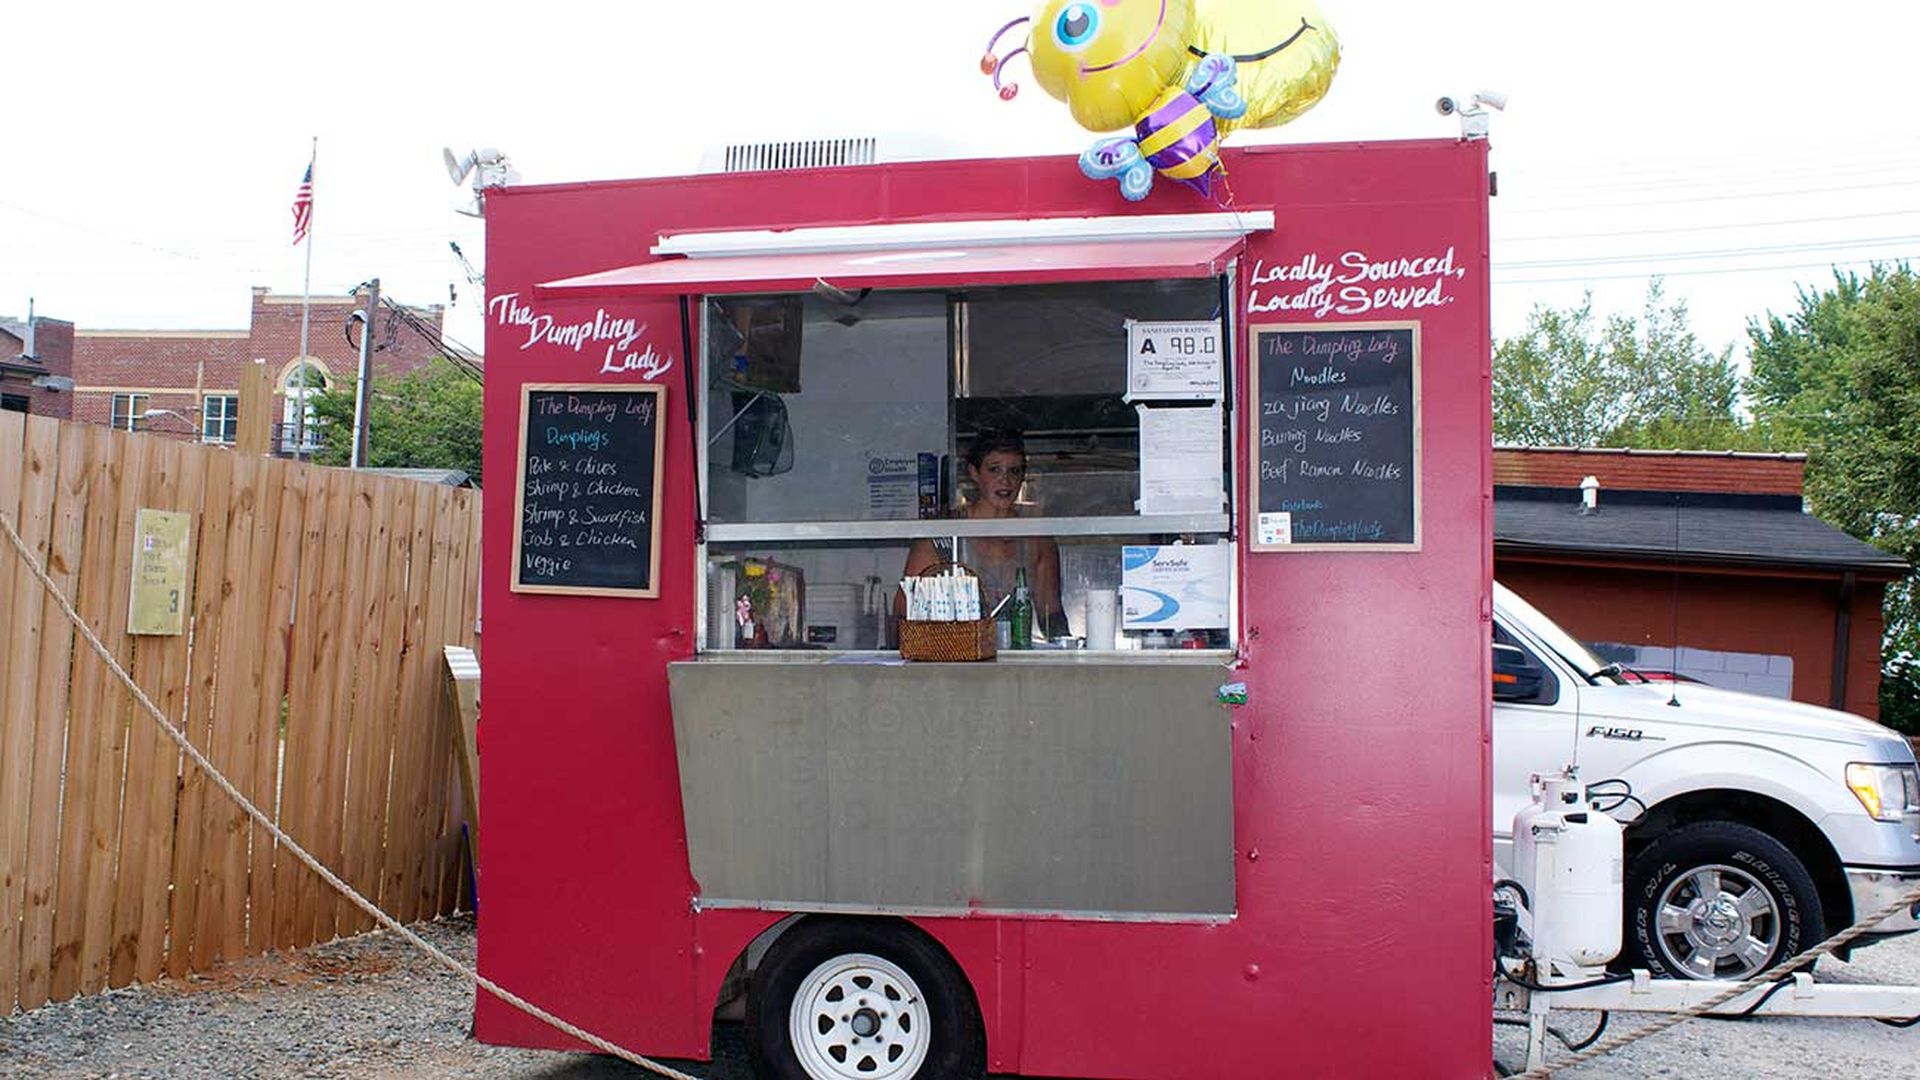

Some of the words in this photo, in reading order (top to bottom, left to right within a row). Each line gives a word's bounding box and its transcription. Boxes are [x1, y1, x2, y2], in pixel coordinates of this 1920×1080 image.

[1250, 253, 1336, 294] Locally
[1336, 246, 1465, 284] Sourced,
[489, 293, 534, 325] The
[1248, 285, 1336, 318] Locally
[1335, 278, 1454, 314] Served.
[520, 308, 646, 351] Dumpling
[1140, 338, 1156, 354] A
[1171, 336, 1215, 355] 98.0
[1264, 336, 1293, 355] The
[1303, 335, 1363, 363] Dumpling
[1368, 335, 1398, 363] Lady
[600, 343, 673, 380] Lady
[1290, 367, 1347, 388] Noodles
[537, 396, 564, 416] The
[568, 395, 617, 422] Dumpling
[625, 396, 654, 426] Lady
[1340, 394, 1400, 416] Noodles
[547, 427, 609, 450] Dumplings
[1315, 427, 1362, 444] Noodles
[1261, 459, 1290, 484] Beef
[1352, 460, 1401, 480] Noodles
[526, 480, 570, 501] Shrimp
[587, 480, 641, 498] Chicken
[524, 503, 565, 529] Shrimp
[576, 531, 638, 549] Chicken
[526, 553, 573, 577] Veggie
[169, 589, 179, 613] 3
